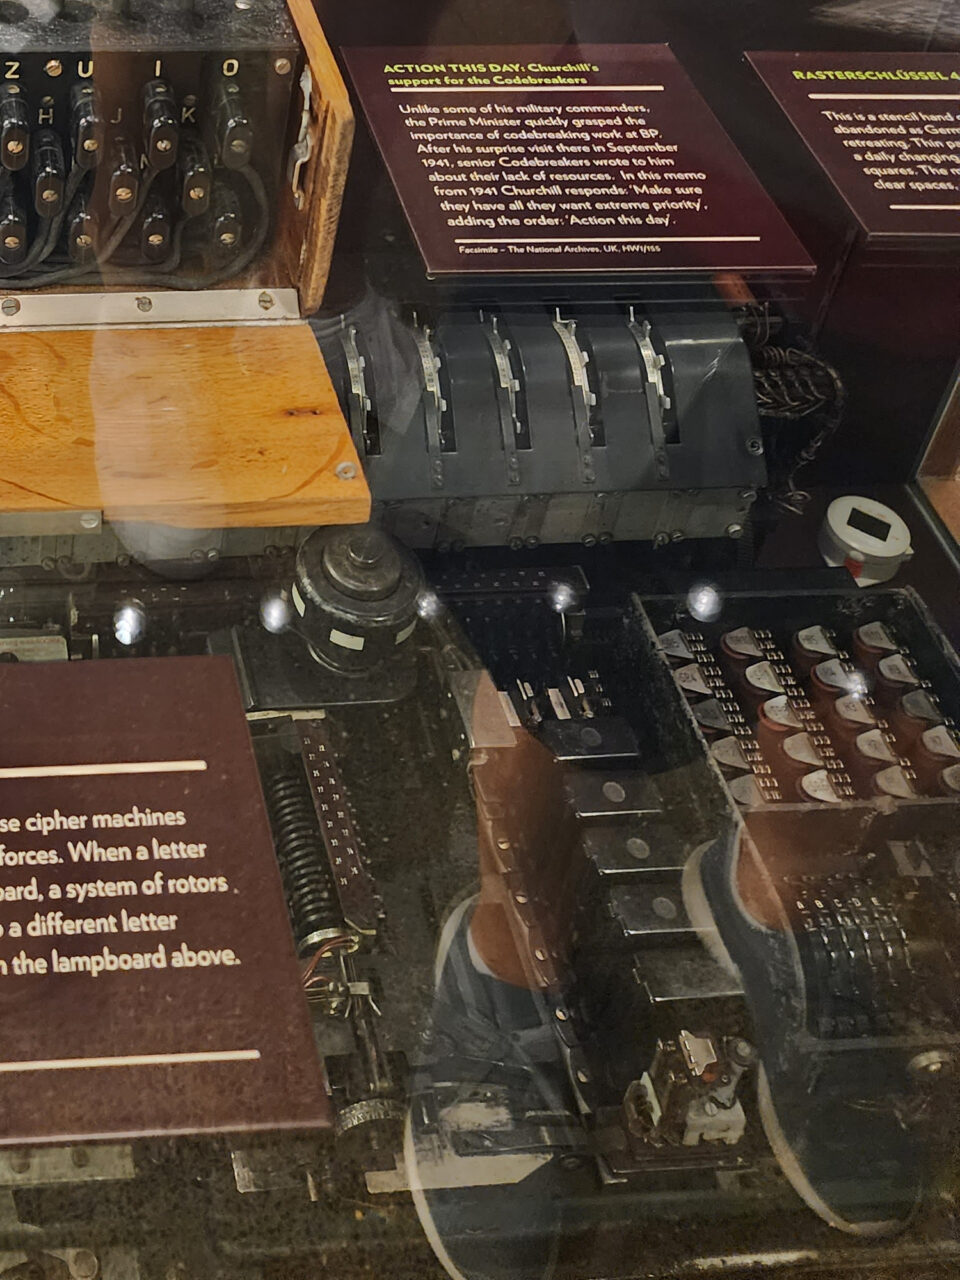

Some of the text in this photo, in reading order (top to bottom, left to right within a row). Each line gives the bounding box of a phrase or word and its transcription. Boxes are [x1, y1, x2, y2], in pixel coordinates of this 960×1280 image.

[4, 61, 20, 79] Z
[77, 61, 94, 78] U
[155, 60, 161, 77] I
[223, 59, 239, 77] O
[384, 63, 599, 73] ACTION THIS DAY: Churchill's
[792, 69, 949, 81] RASTERSCHLÜSSEL
[388, 76, 587, 87] support for the Codebreakers
[399, 104, 650, 115] Unlike some of his military commanders,
[821, 110, 853, 121] This
[854, 112, 866, 121] is
[878, 112, 919, 121] stencil
[918, 111, 954, 121] hand
[405, 117, 646, 128] the Prime Minister quickly grasped the
[410, 129, 662, 142] importance of codebreaking work at BP.
[833, 125, 907, 135] abandoned
[909, 127, 923, 135] as
[417, 143, 678, 155] After his surprise visit there in September
[842, 139, 910, 150] retreating.
[909, 137, 944, 148] Thin
[421, 156, 675, 168] 1941, senior Codebreakers wrote to him
[854, 152, 960, 164] a daily changing
[428, 170, 706, 182] about their lack of resources. In this memo
[863, 165, 948, 177] squares. The
[434, 186, 467, 196] from
[469, 187, 498, 196] 1941
[501, 185, 562, 196] Churchill
[565, 185, 628, 197] responds:
[675, 187, 703, 195] sure
[874, 180, 906, 190] clear
[440, 200, 470, 213] they
[472, 200, 505, 211] have
[509, 200, 524, 211] all
[526, 200, 556, 212] they
[559, 202, 592, 211] want
[595, 201, 650, 210] extreme
[447, 215, 495, 228] adding
[497, 216, 520, 226] the
[523, 215, 564, 226] order:
[617, 215, 643, 225] this
[459, 246, 498, 254] Facsimile
[507, 245, 524, 253] The
[526, 245, 562, 253] National
[25, 809, 88, 835] cipher
[92, 806, 187, 828] machines
[67, 840, 132, 862] When
[136, 845, 149, 861] a
[152, 837, 207, 860] letter
[48, 883, 62, 900] a
[66, 879, 138, 903] system
[141, 871, 164, 895] of
[168, 875, 228, 894] rotors
[8, 922, 22, 938] a
[26, 911, 118, 937] different
[121, 908, 178, 933] letter
[12, 950, 48, 975] the
[51, 943, 167, 978] lampboard
[171, 942, 241, 968] above.
